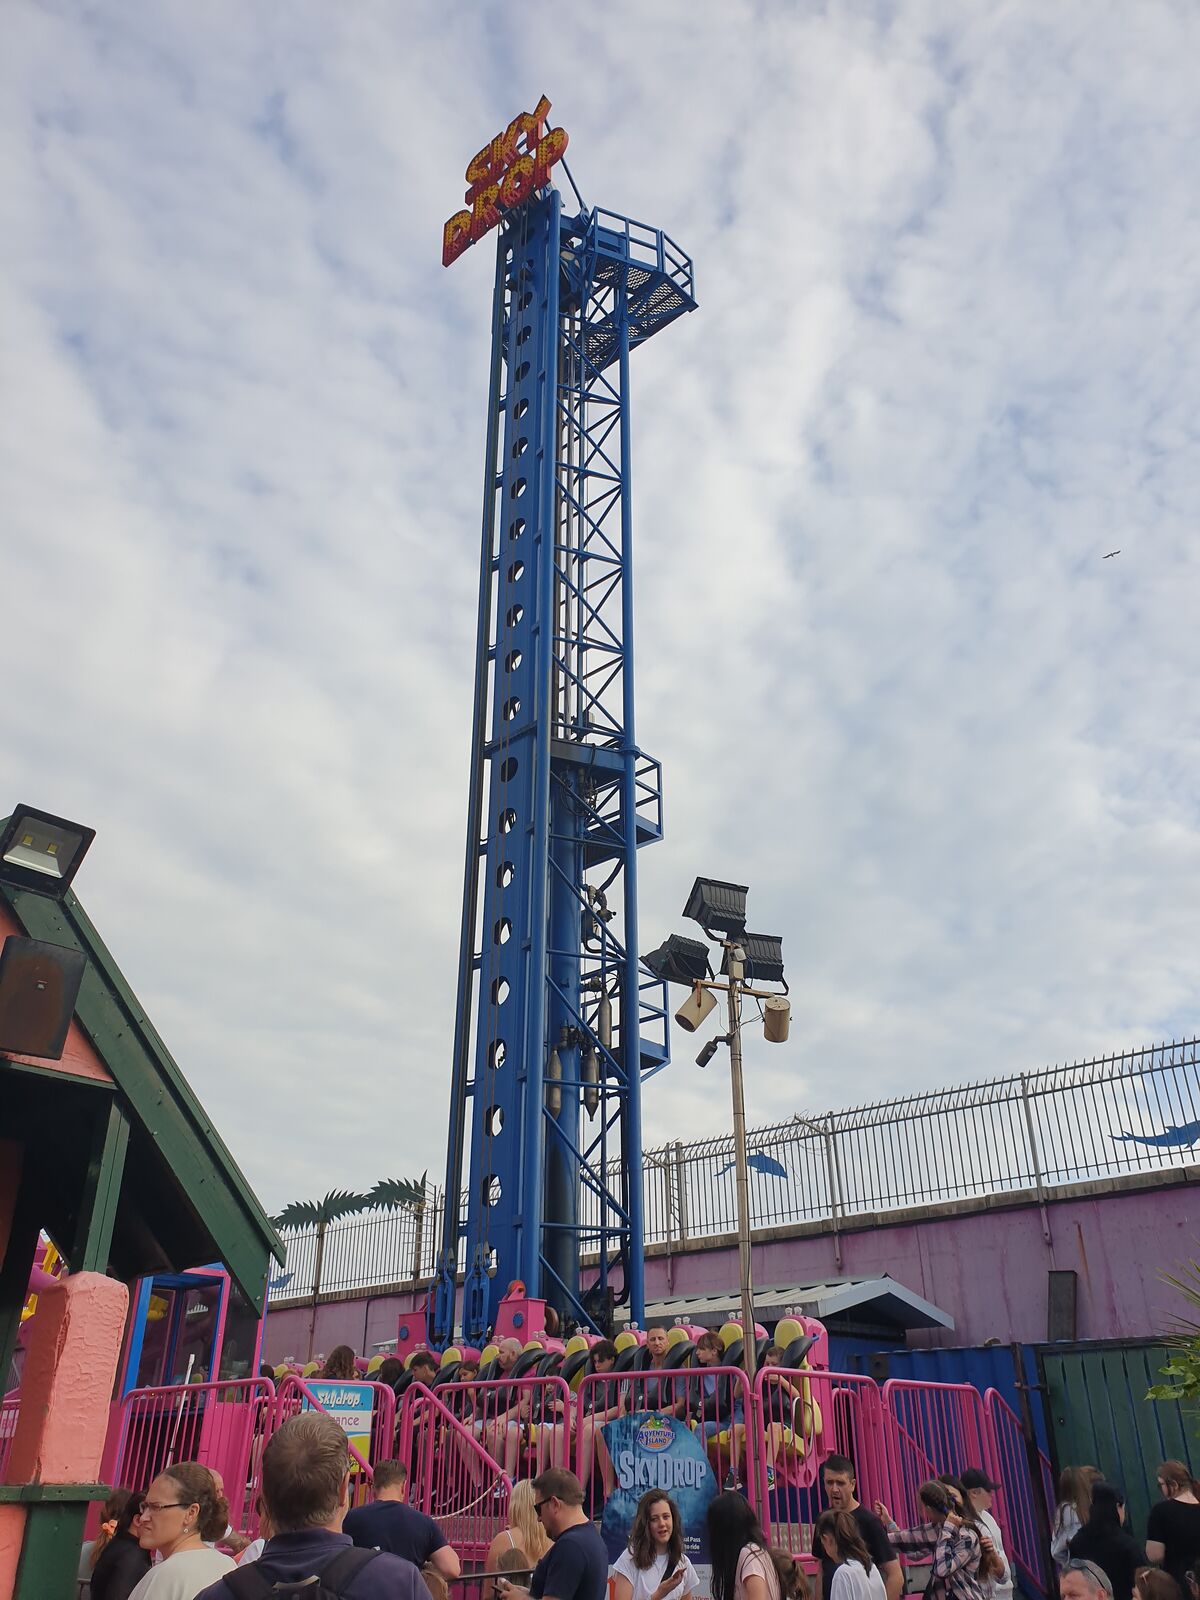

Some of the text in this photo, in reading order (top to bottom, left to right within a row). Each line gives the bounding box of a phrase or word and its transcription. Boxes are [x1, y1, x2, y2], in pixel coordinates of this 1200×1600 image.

[465, 94, 552, 206] SKY
[442, 127, 569, 268] DROP
[335, 1416, 360, 1426] ance
[636, 1429, 676, 1441] ADVENTURE
[645, 1437, 668, 1445] ISLAND
